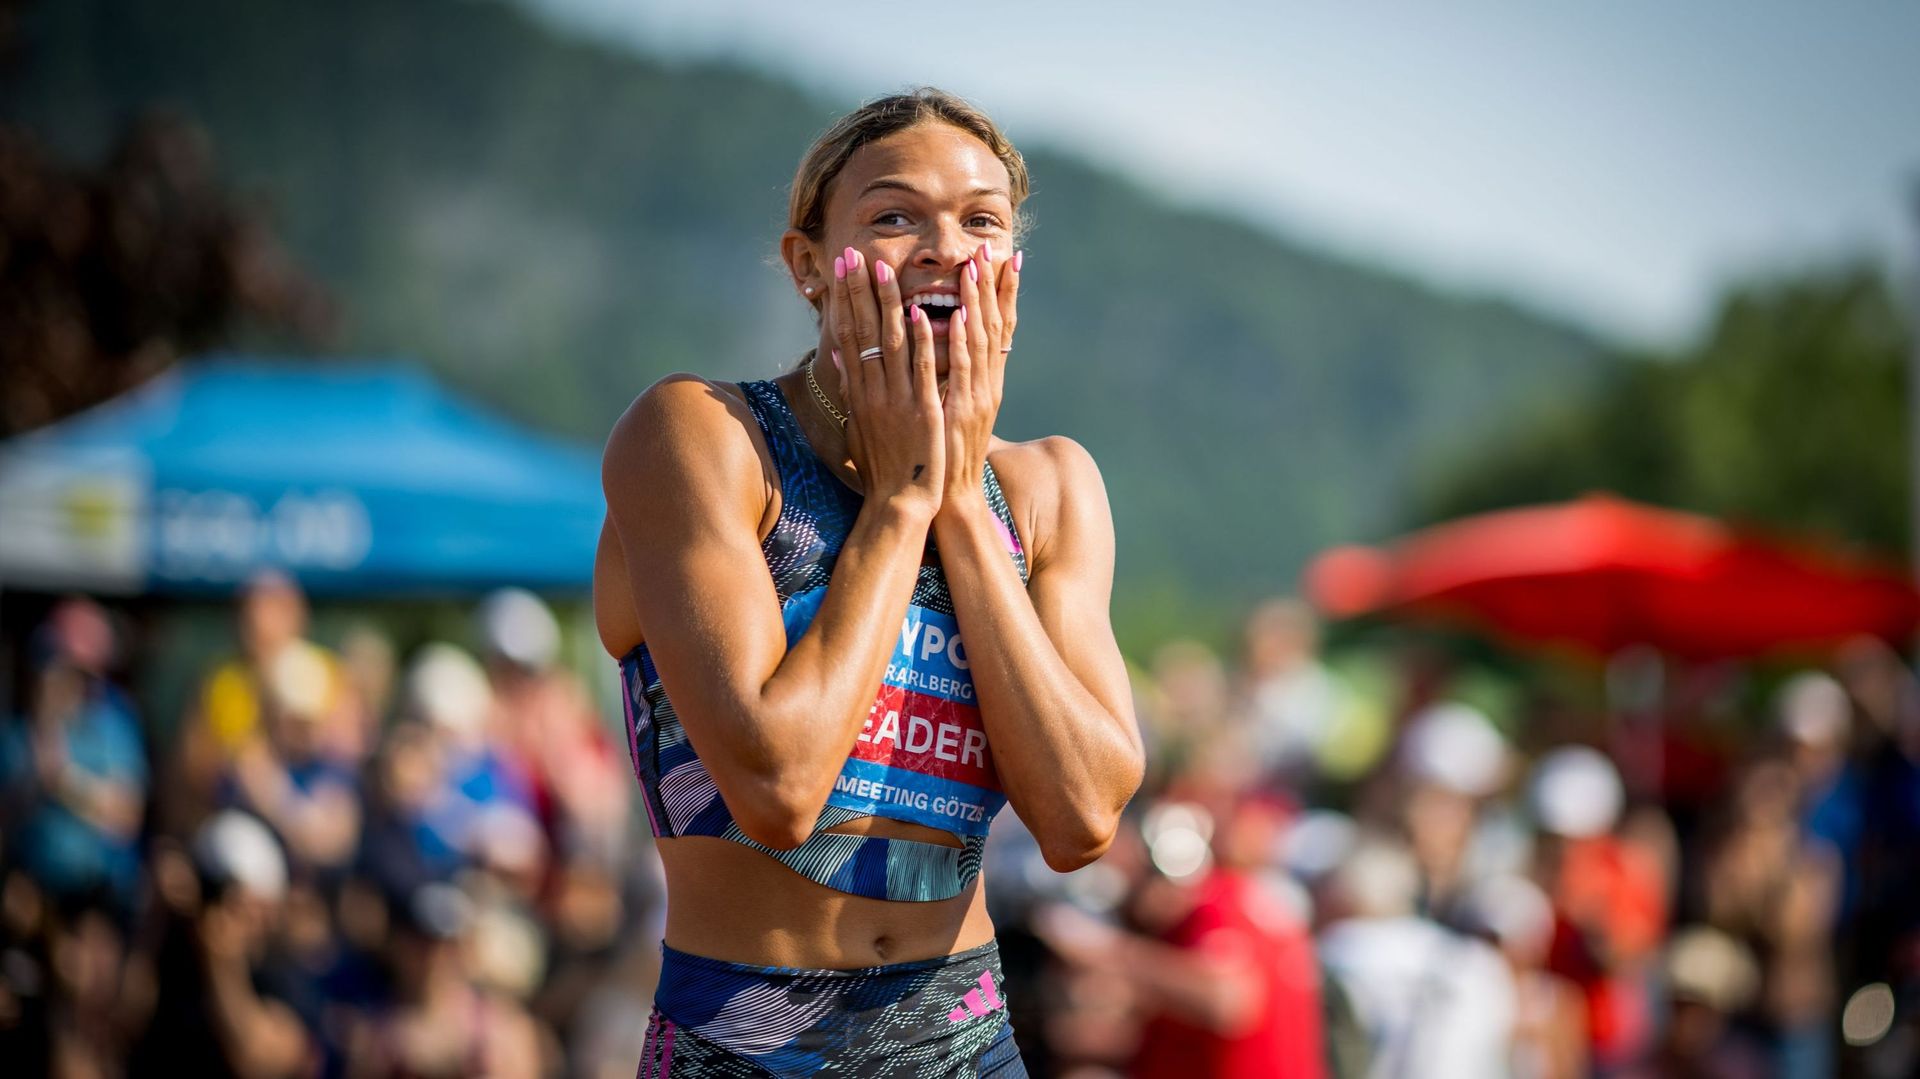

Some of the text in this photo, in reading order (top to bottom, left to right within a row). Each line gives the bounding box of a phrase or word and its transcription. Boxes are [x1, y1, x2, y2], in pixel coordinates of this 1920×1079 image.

[901, 617, 969, 670] YPO
[883, 663, 972, 699] RARLBERG
[857, 706, 987, 768] EADER
[834, 775, 929, 811] MEETING
